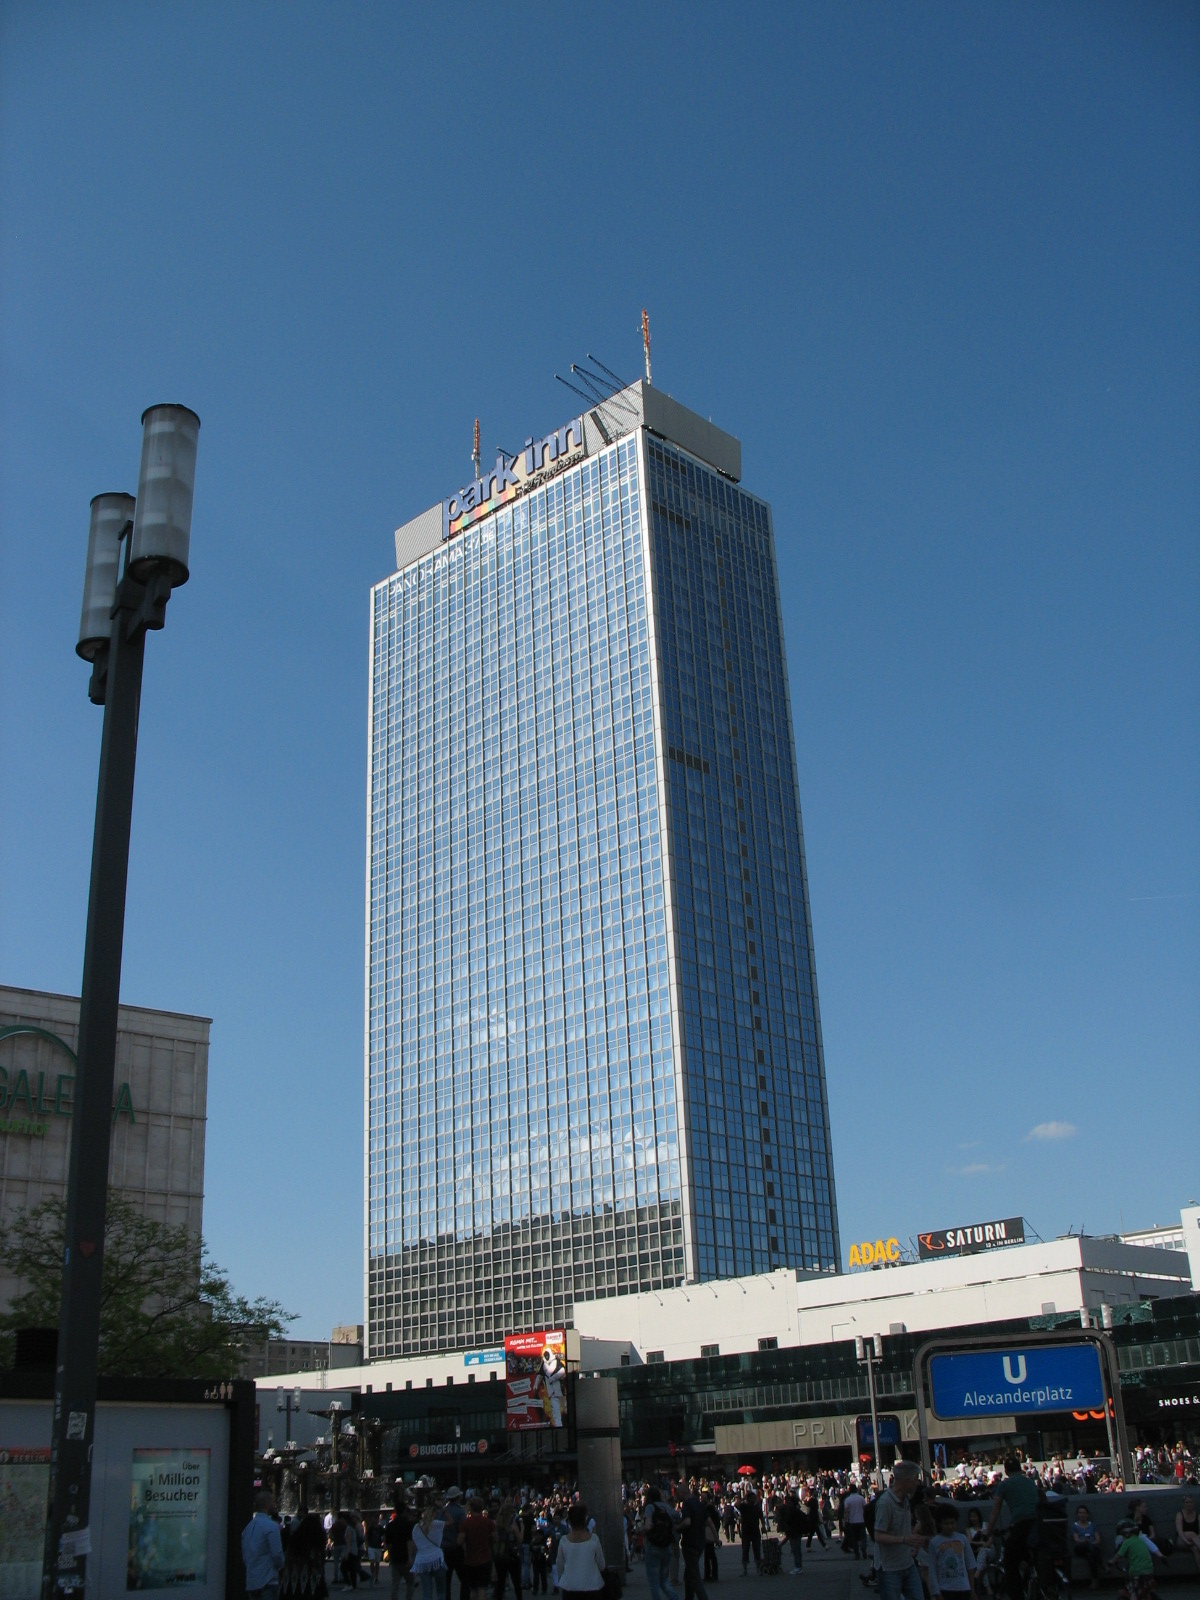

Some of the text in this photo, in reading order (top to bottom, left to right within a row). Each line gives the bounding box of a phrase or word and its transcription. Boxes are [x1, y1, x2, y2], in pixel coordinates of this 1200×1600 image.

[442, 455, 520, 541] park
[525, 418, 583, 476] inn
[945, 1222, 1007, 1248] SATURN
[1004, 1237, 1024, 1245] BERLIN
[849, 1237, 901, 1267] ADAC
[1002, 1355, 1027, 1384] U
[963, 1386, 1073, 1407] Alexanderplatz
[1158, 1397, 1190, 1407] SHOES
[420, 1443, 453, 1456] BURGER
[182, 1461, 200, 1470] Über
[158, 1473, 200, 1486] Million
[145, 1489, 199, 1501] Besucher
